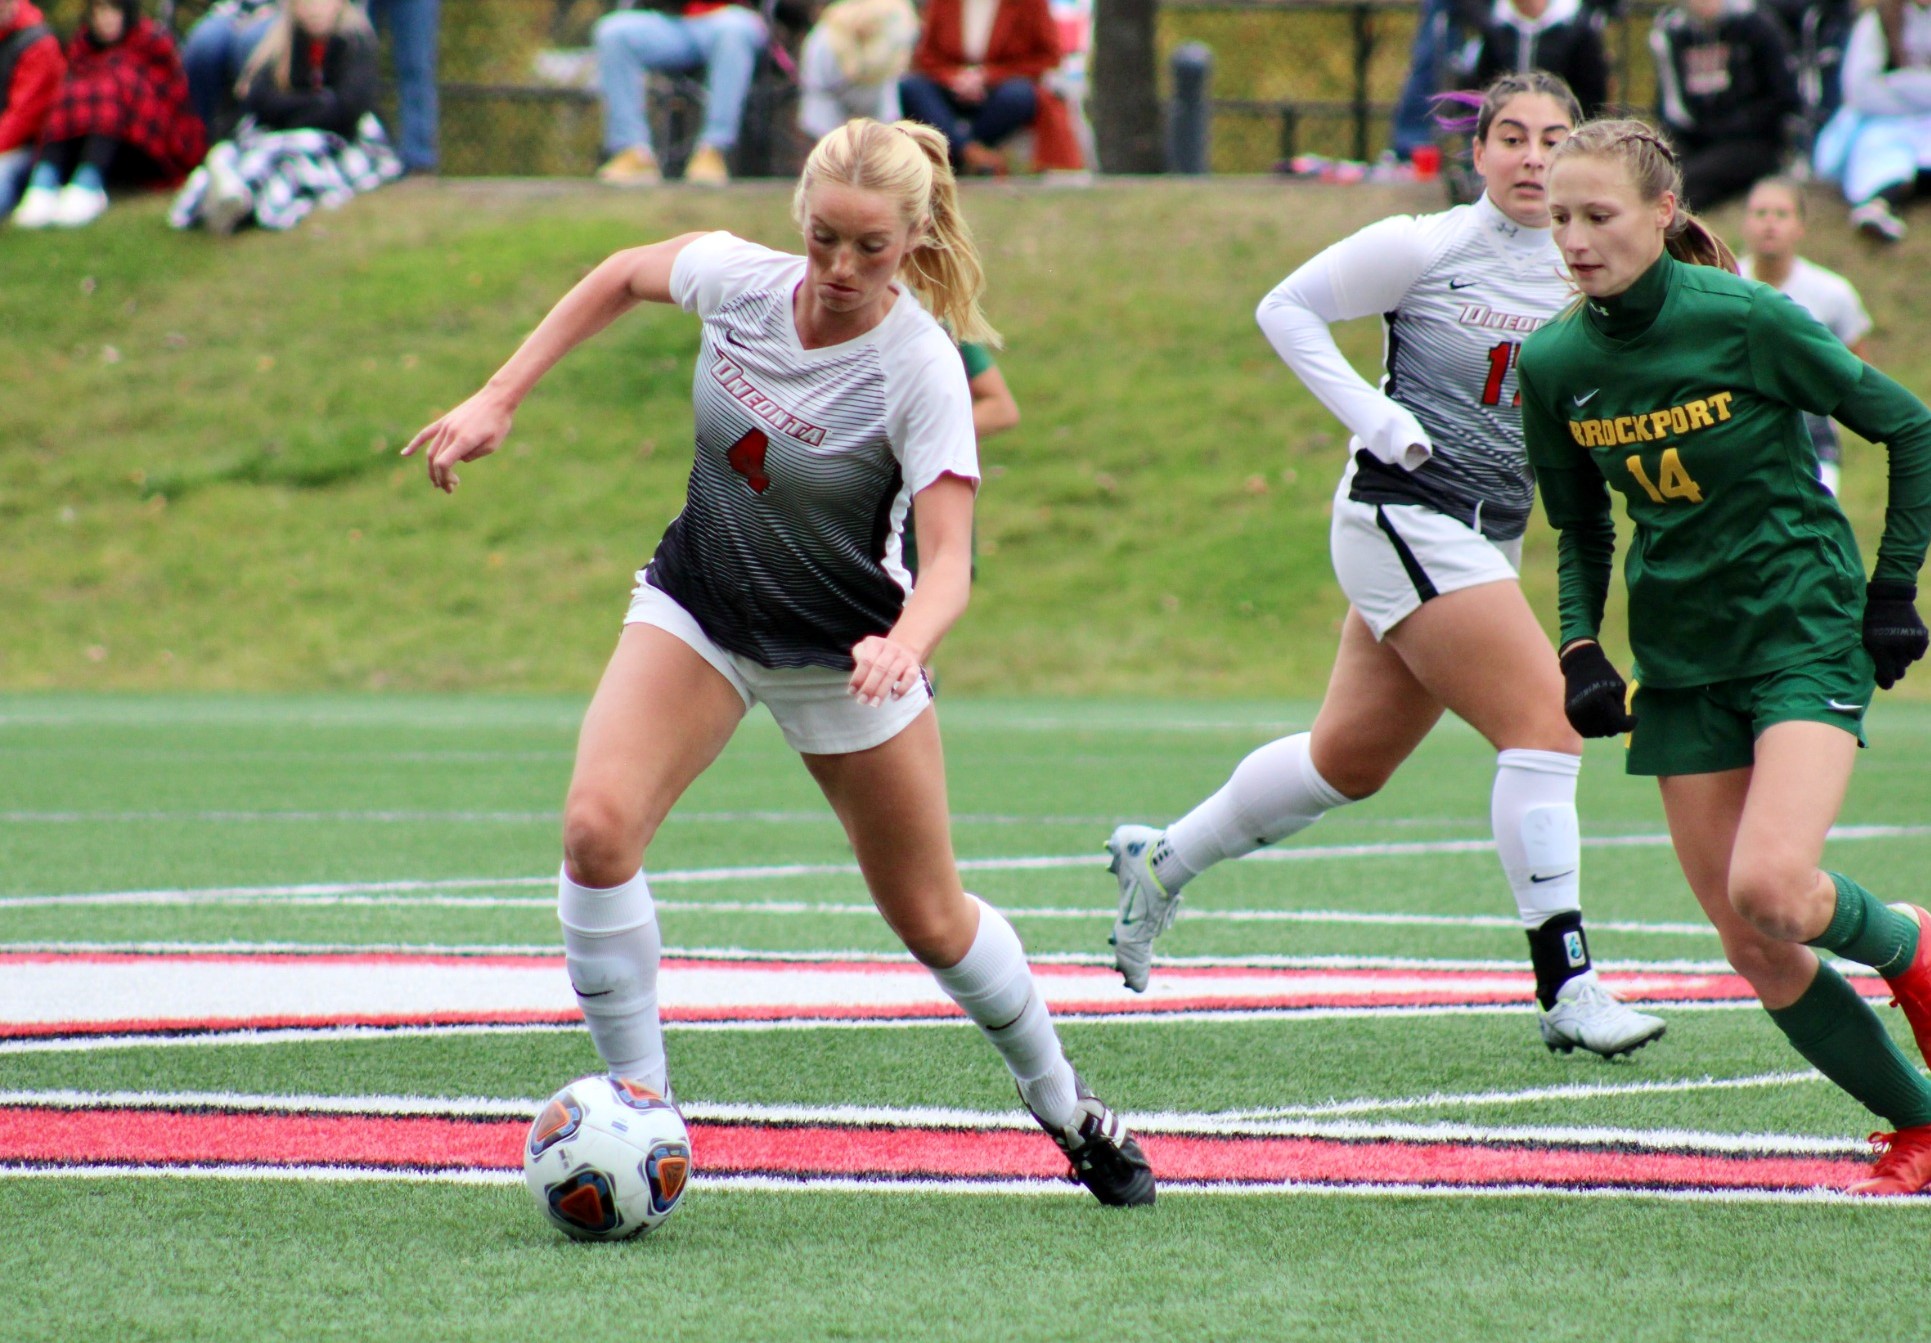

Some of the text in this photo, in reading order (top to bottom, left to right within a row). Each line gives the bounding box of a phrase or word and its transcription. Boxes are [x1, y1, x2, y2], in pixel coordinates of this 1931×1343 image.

[711, 343, 827, 447] ONEONTA
[1569, 391, 1732, 447] BROCKPORT
[1626, 447, 1704, 504] 14
